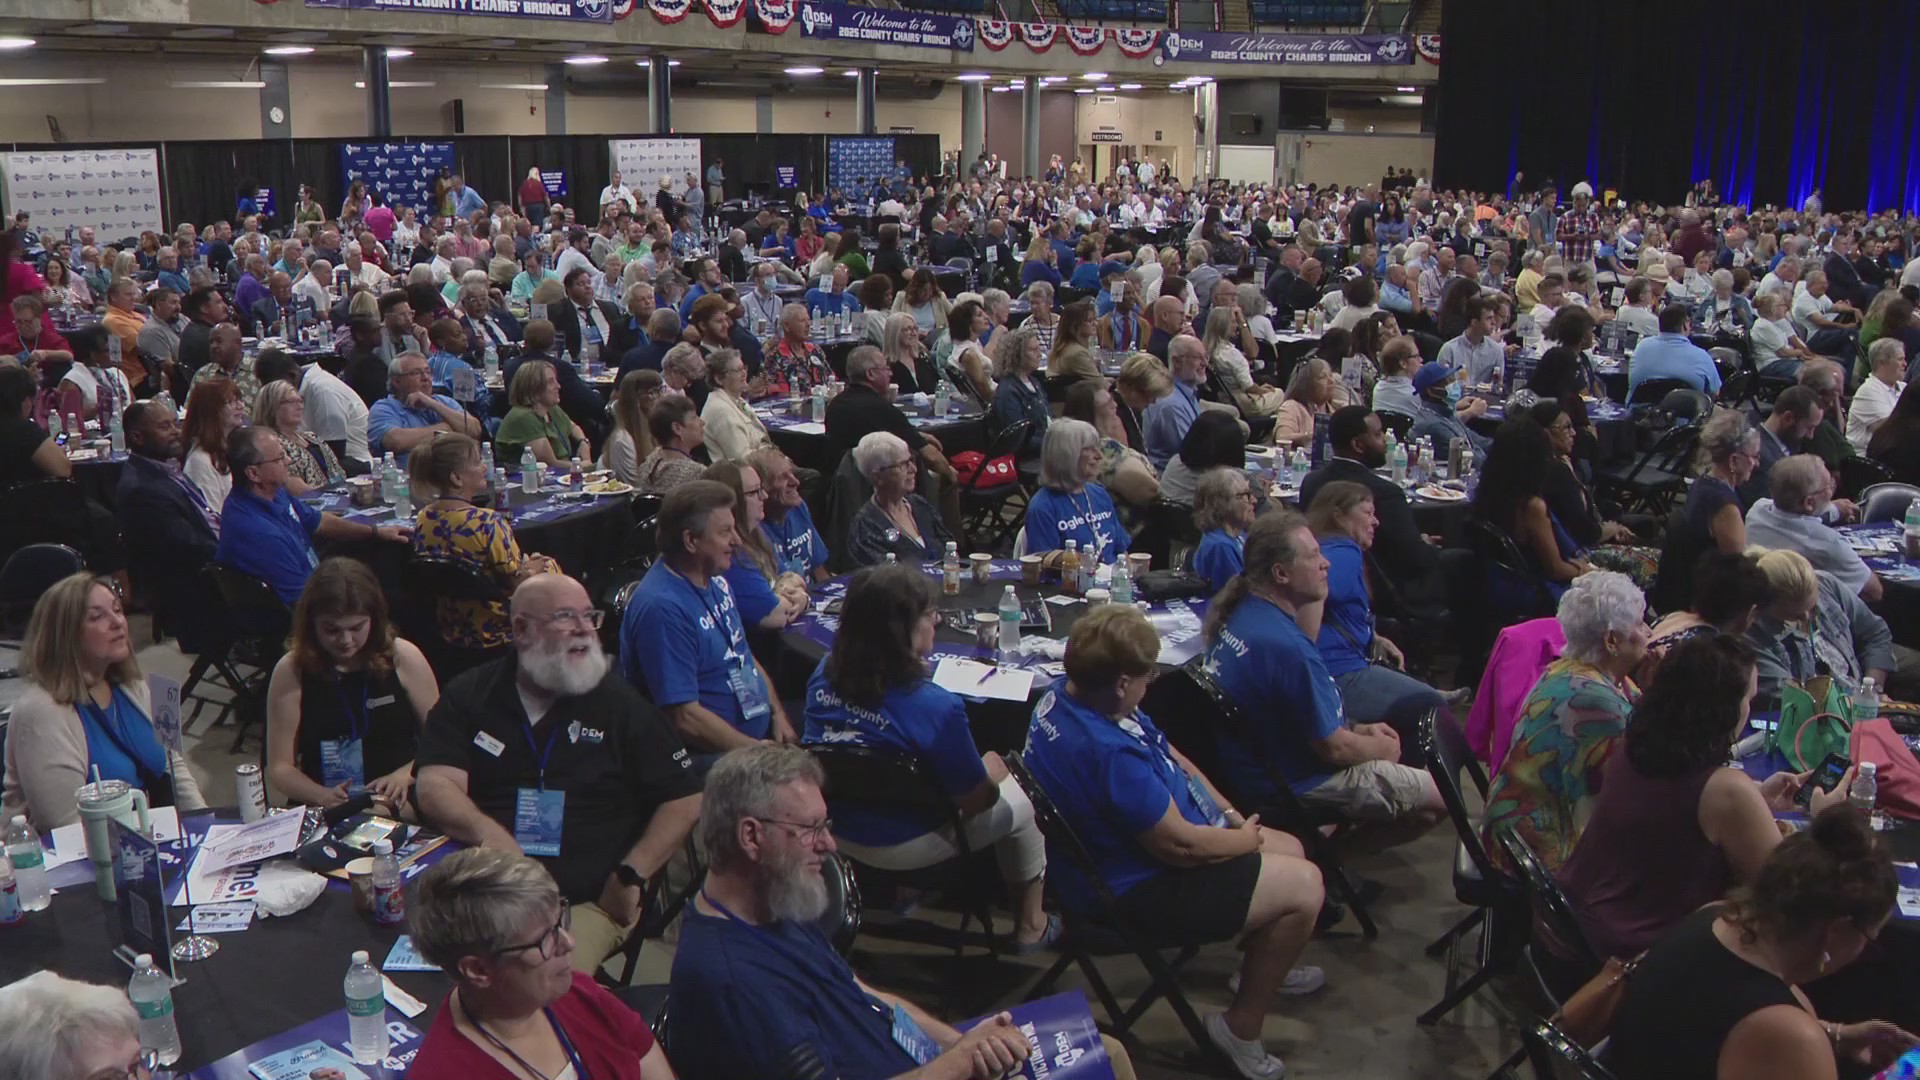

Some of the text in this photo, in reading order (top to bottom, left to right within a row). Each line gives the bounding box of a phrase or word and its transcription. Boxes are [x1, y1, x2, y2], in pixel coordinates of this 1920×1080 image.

[414, 0, 468, 9] COUNTY
[472, 0, 521, 12] CHAIRS'
[523, 1, 571, 16] BRUNCH
[814, 12, 833, 23] DEM
[852, 11, 938, 33] Welcome to the
[839, 27, 951, 45] 2025 COUNTY CHAIRS' BRUNCH
[1230, 36, 1352, 52] Welcome to the
[1180, 40, 1203, 49] DEM
[1210, 50, 1372, 63] 2025 COUNTY CHAIRS' BRUNCH
[1092, 133, 1122, 141] RESTROOMS
[1058, 515, 1085, 531] Ogle
[167, 687, 179, 703] 67
[815, 688, 891, 731] Ogle County
[581, 727, 604, 740] DEM
